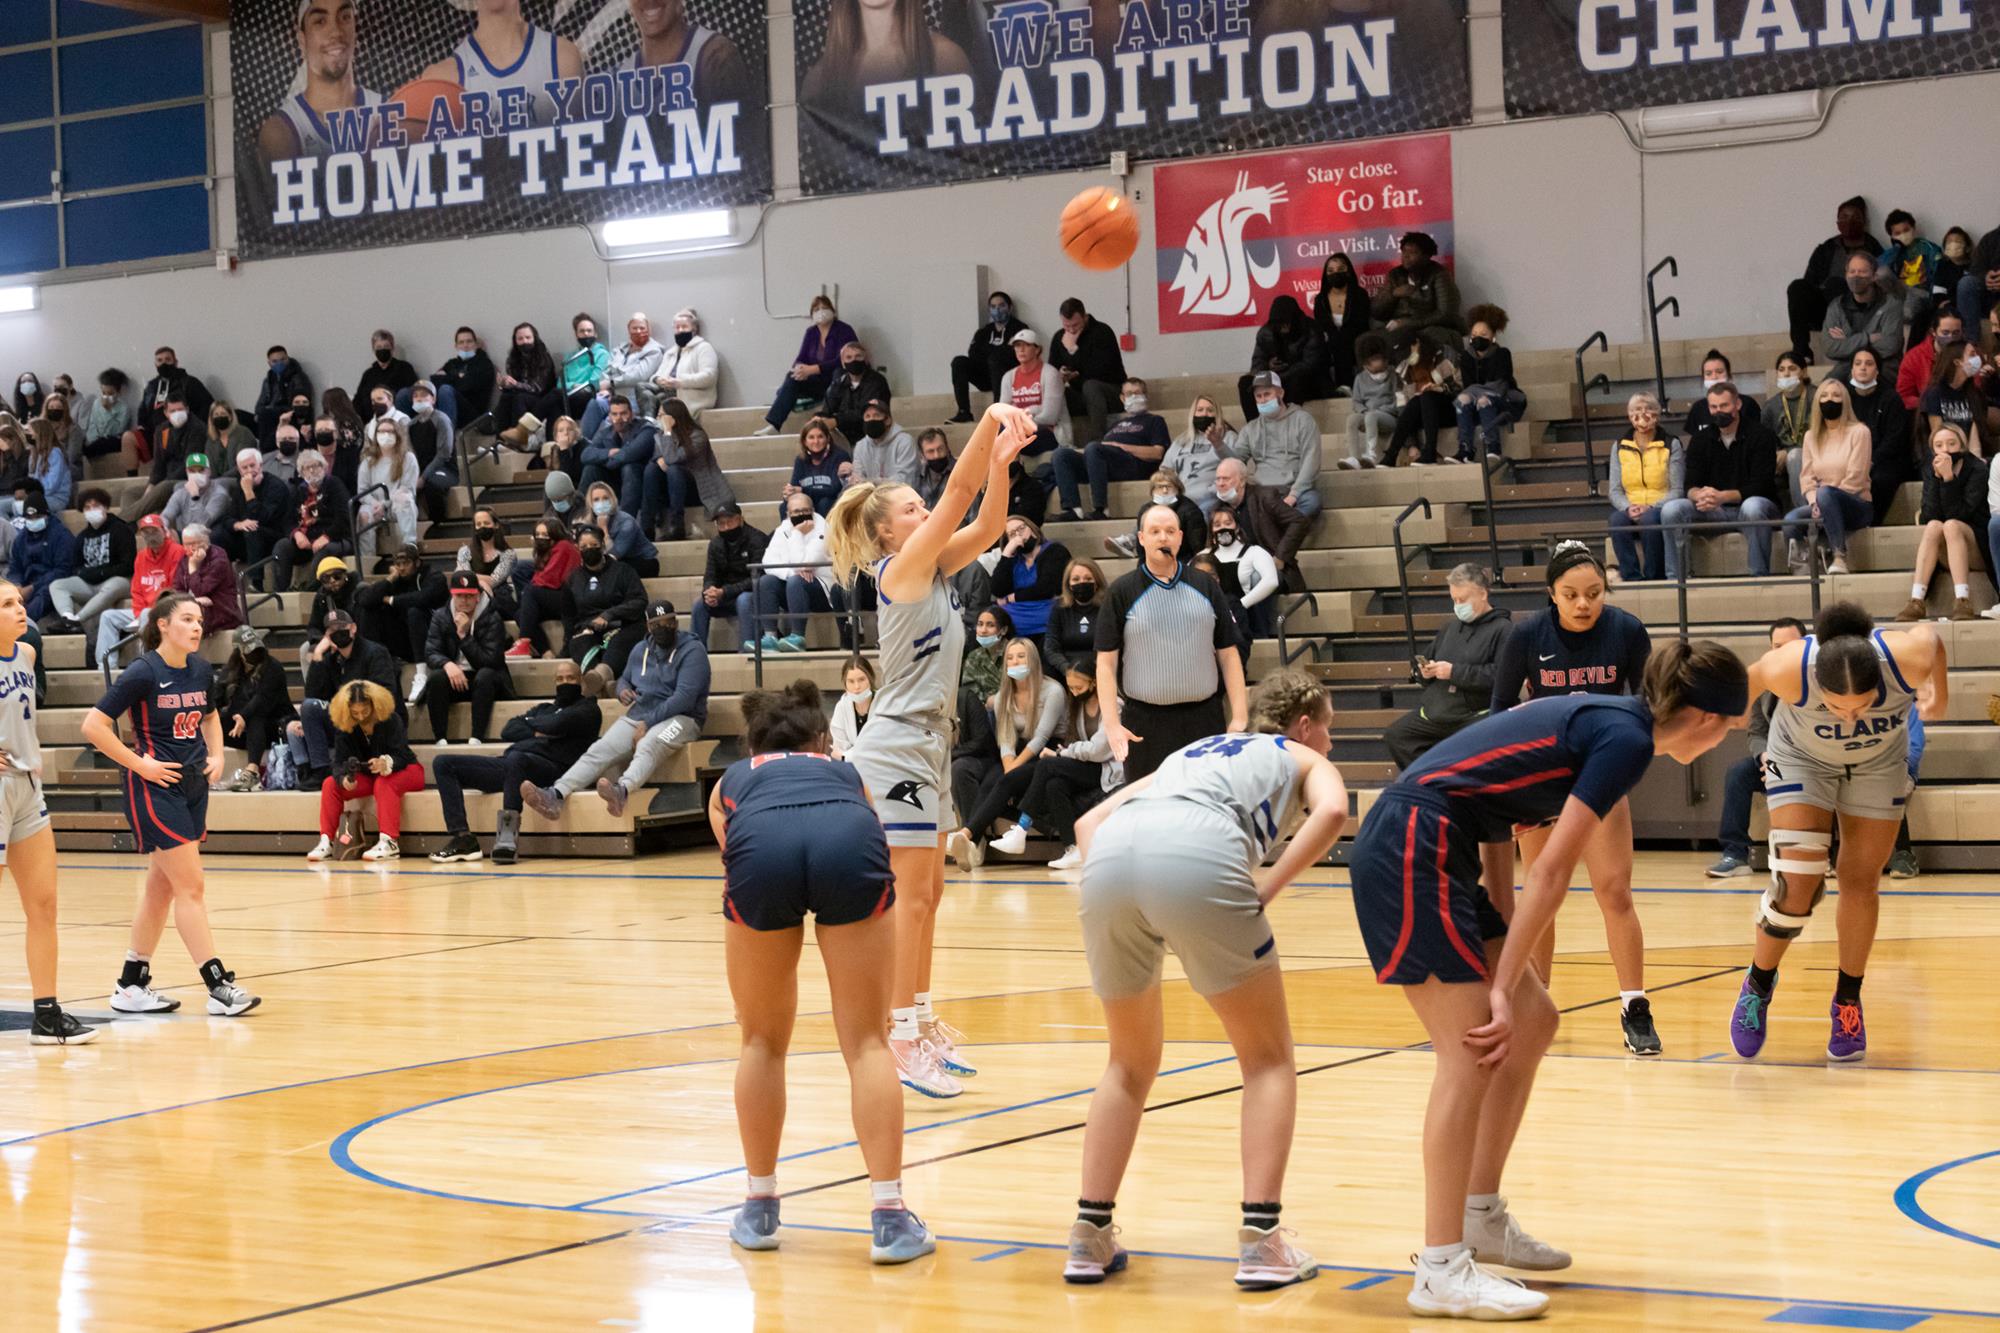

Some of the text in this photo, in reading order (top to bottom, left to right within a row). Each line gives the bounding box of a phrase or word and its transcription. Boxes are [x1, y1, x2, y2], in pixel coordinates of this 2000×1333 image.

[987, 0, 1251, 69] WE ARE
[865, 18, 1396, 155] TRADITION
[325, 61, 698, 155] WE ARE YOUR
[271, 102, 742, 225] HOME TEAM
[1307, 161, 1398, 186] Stay close.
[1337, 184, 1423, 213] Go far.
[1297, 240, 1334, 257] Call.
[1339, 236, 1380, 254] Visit.
[1540, 665, 1617, 687] RED DEVILS
[1814, 711, 1905, 740] CLARK
